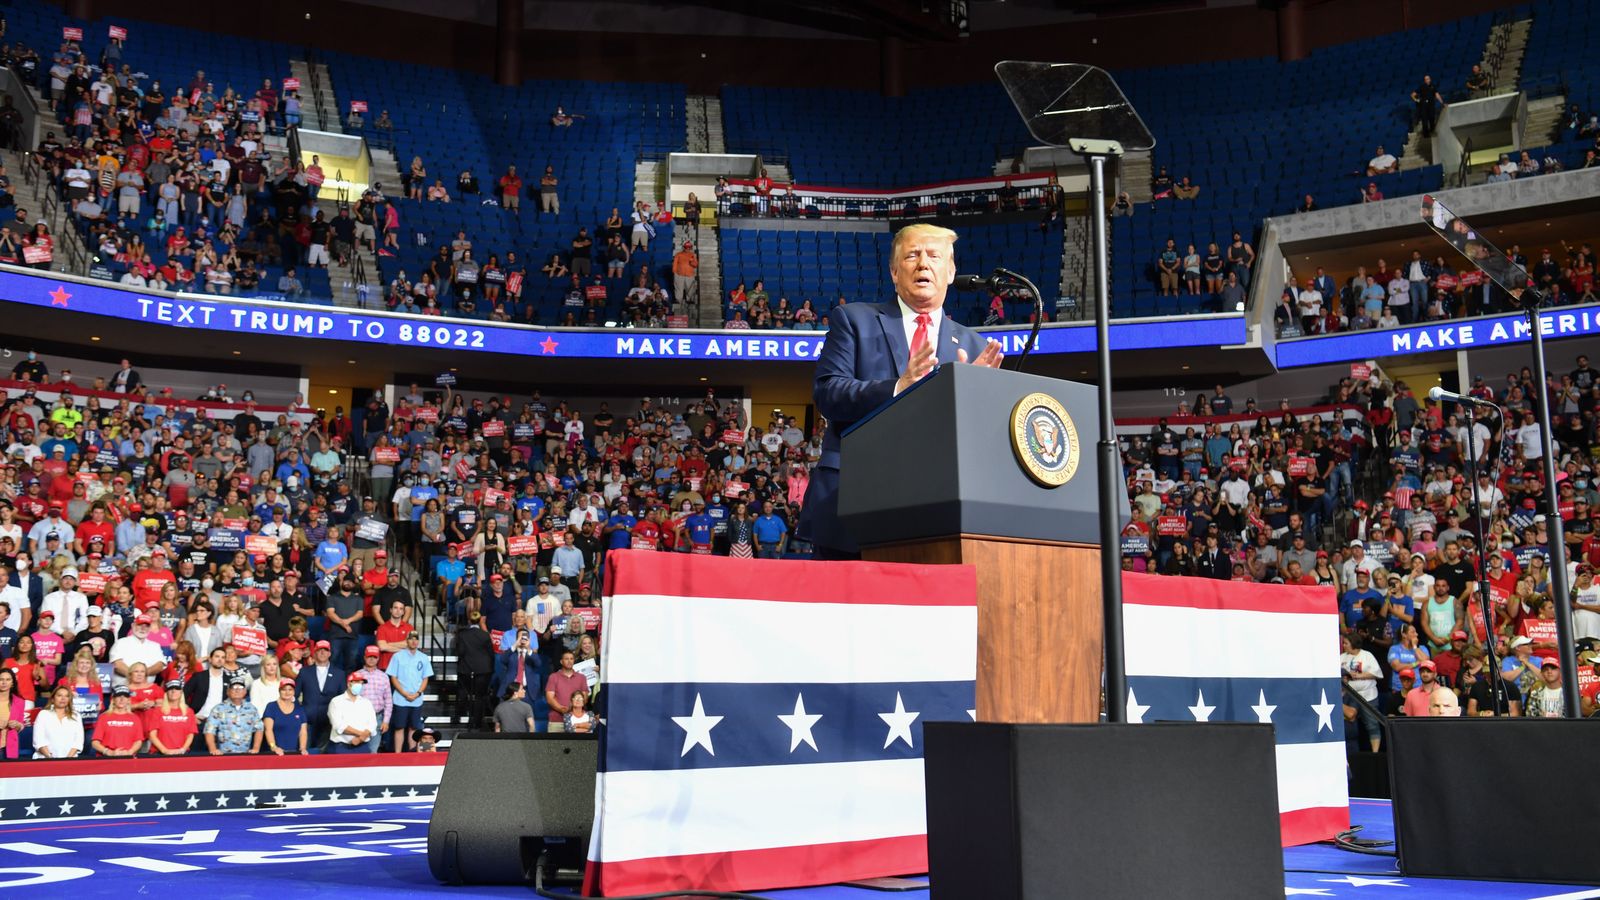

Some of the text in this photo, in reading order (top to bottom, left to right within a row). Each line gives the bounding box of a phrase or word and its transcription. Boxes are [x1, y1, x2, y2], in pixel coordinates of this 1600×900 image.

[138, 298, 485, 348] TEXT TRUMP TO 88022
[1393, 312, 1600, 351] MAKE AMERI
[616, 337, 692, 356] MAKE
[988, 334, 1039, 352] IN!
[658, 397, 680, 405] 114
[235, 634, 265, 645] AMERICA
